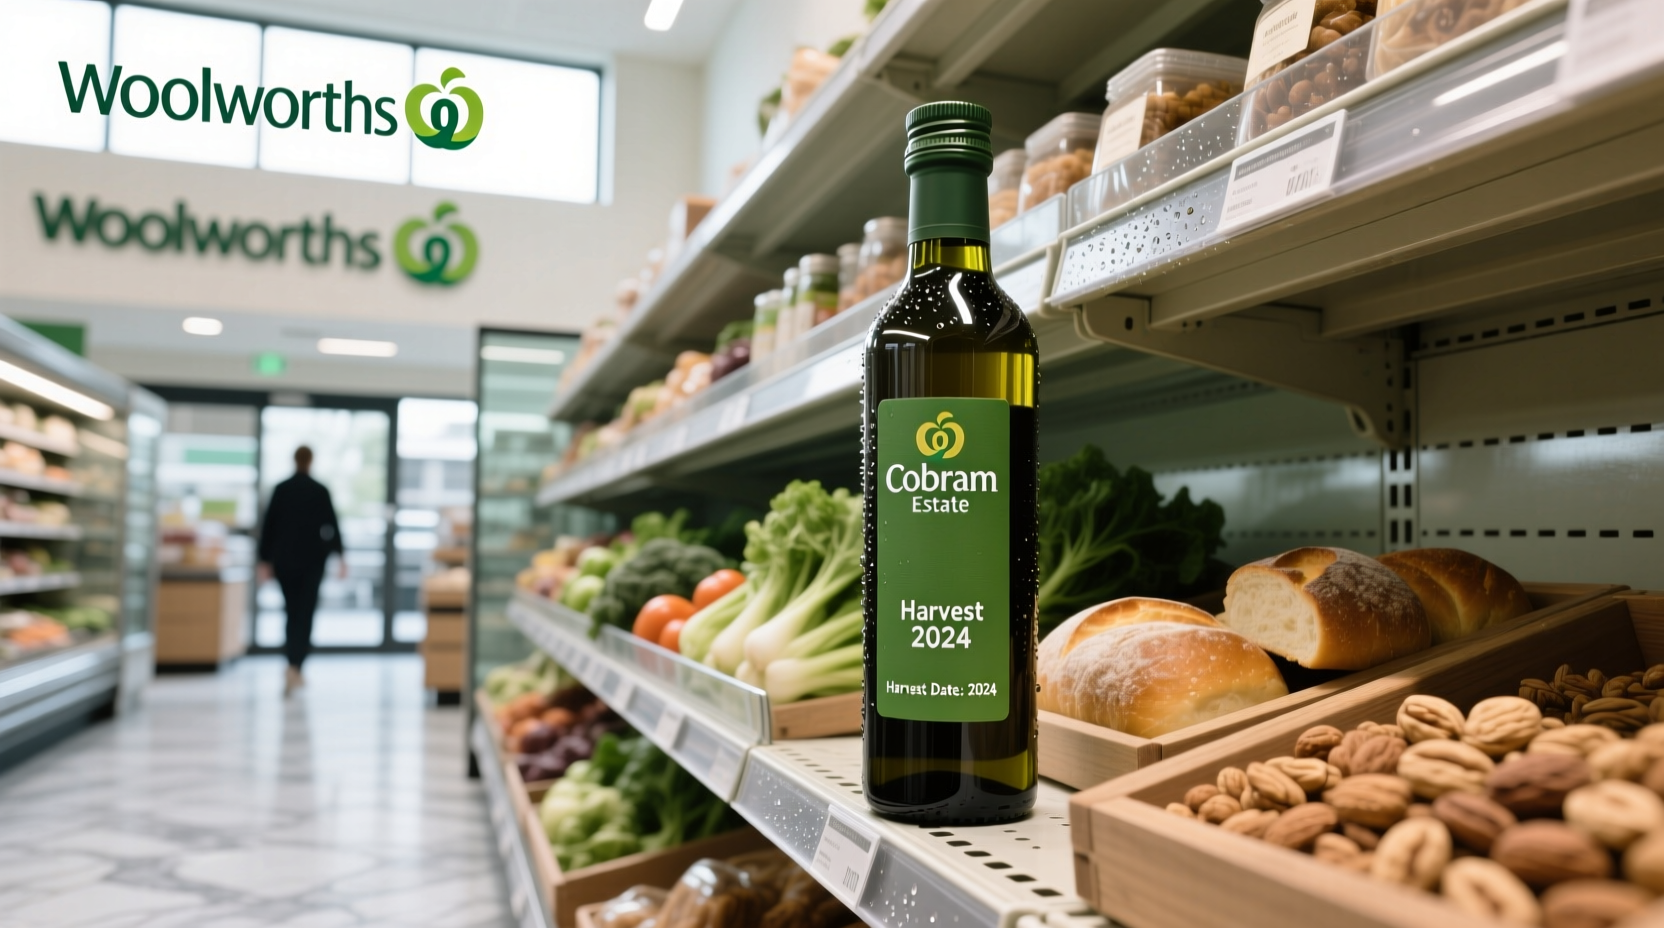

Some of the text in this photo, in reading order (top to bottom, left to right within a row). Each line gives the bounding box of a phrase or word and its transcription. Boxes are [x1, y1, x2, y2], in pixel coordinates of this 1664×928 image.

[58, 61, 398, 136] Woolworths
[33, 192, 382, 270] Woolworths
[885, 462, 999, 494] Cobram
[912, 495, 970, 513] Estate
[901, 599, 984, 622] Harvest
[911, 625, 972, 649] 2024
[930, 682, 964, 697] Date:
[967, 682, 998, 697] 2024
